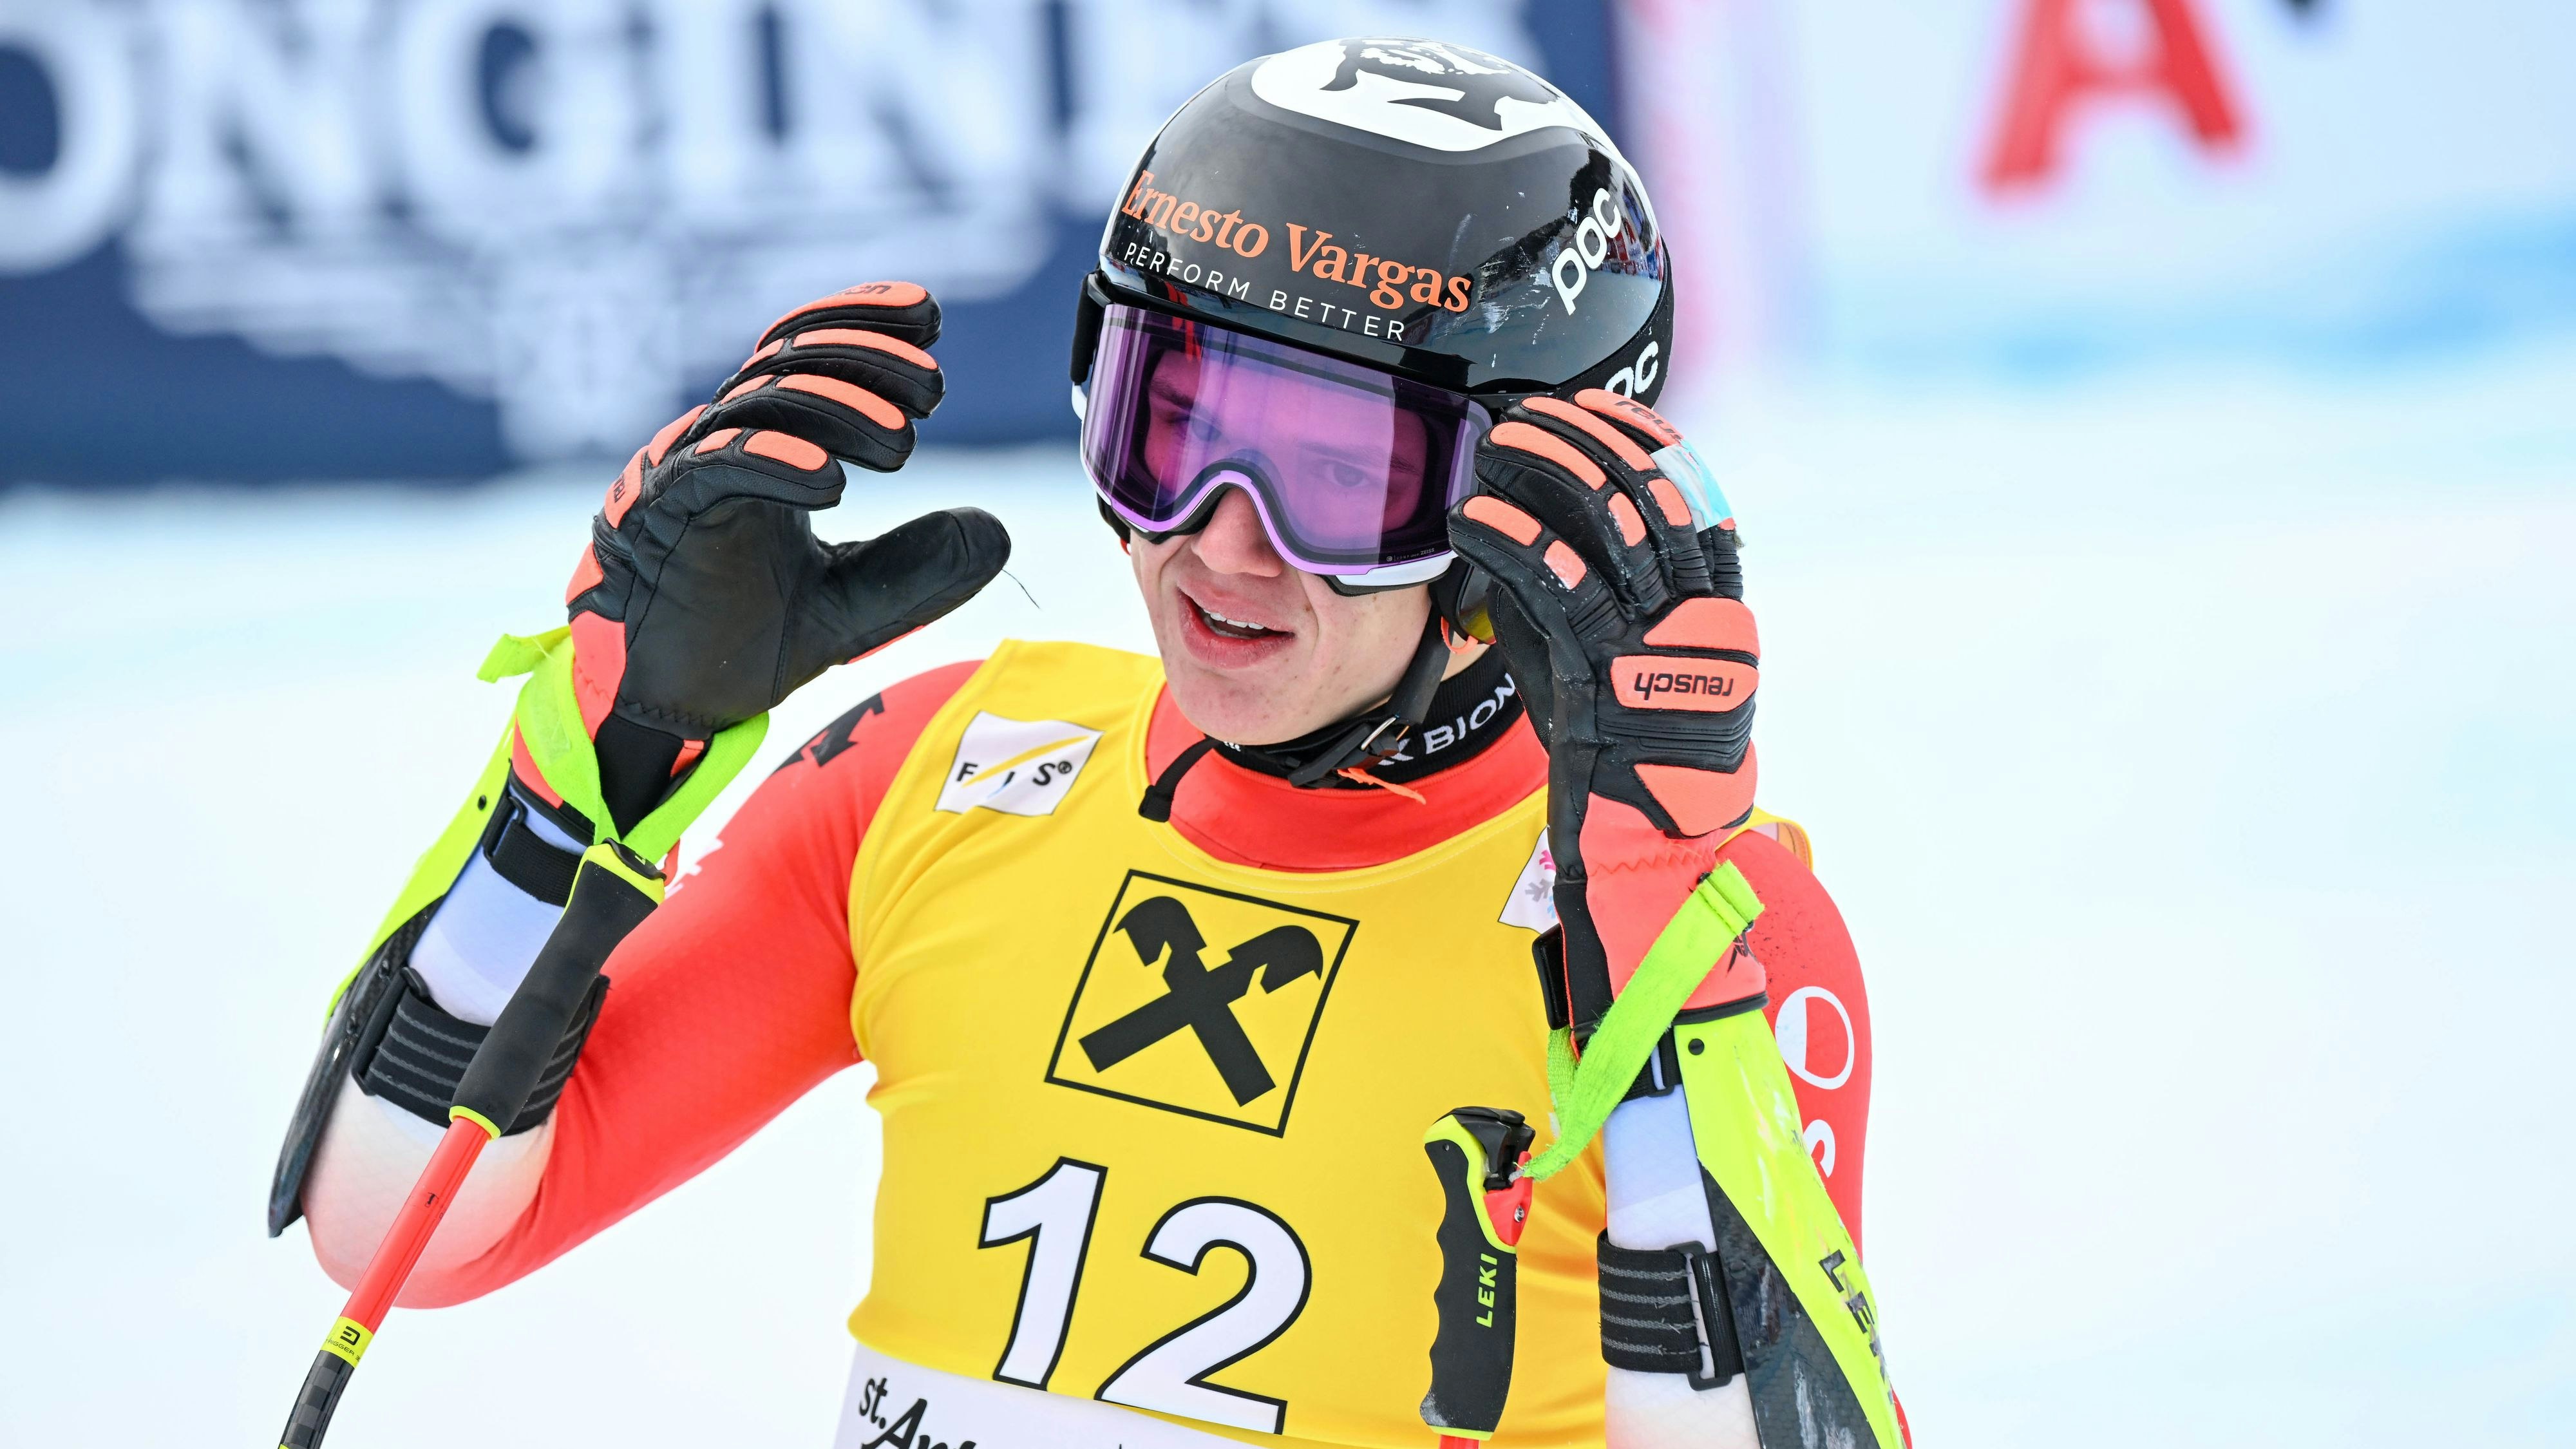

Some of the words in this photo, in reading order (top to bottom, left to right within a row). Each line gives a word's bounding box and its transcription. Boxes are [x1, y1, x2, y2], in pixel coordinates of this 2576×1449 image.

[1121, 169, 1270, 258] Ernesto
[1285, 222, 1472, 312] Vargas
[1124, 242, 1251, 300] PERFORM
[1269, 290, 1405, 342] BETTER
[1634, 672, 1734, 701] reusch
[978, 1156, 1312, 1435] 12
[1475, 1253, 1498, 1328] LEKI
